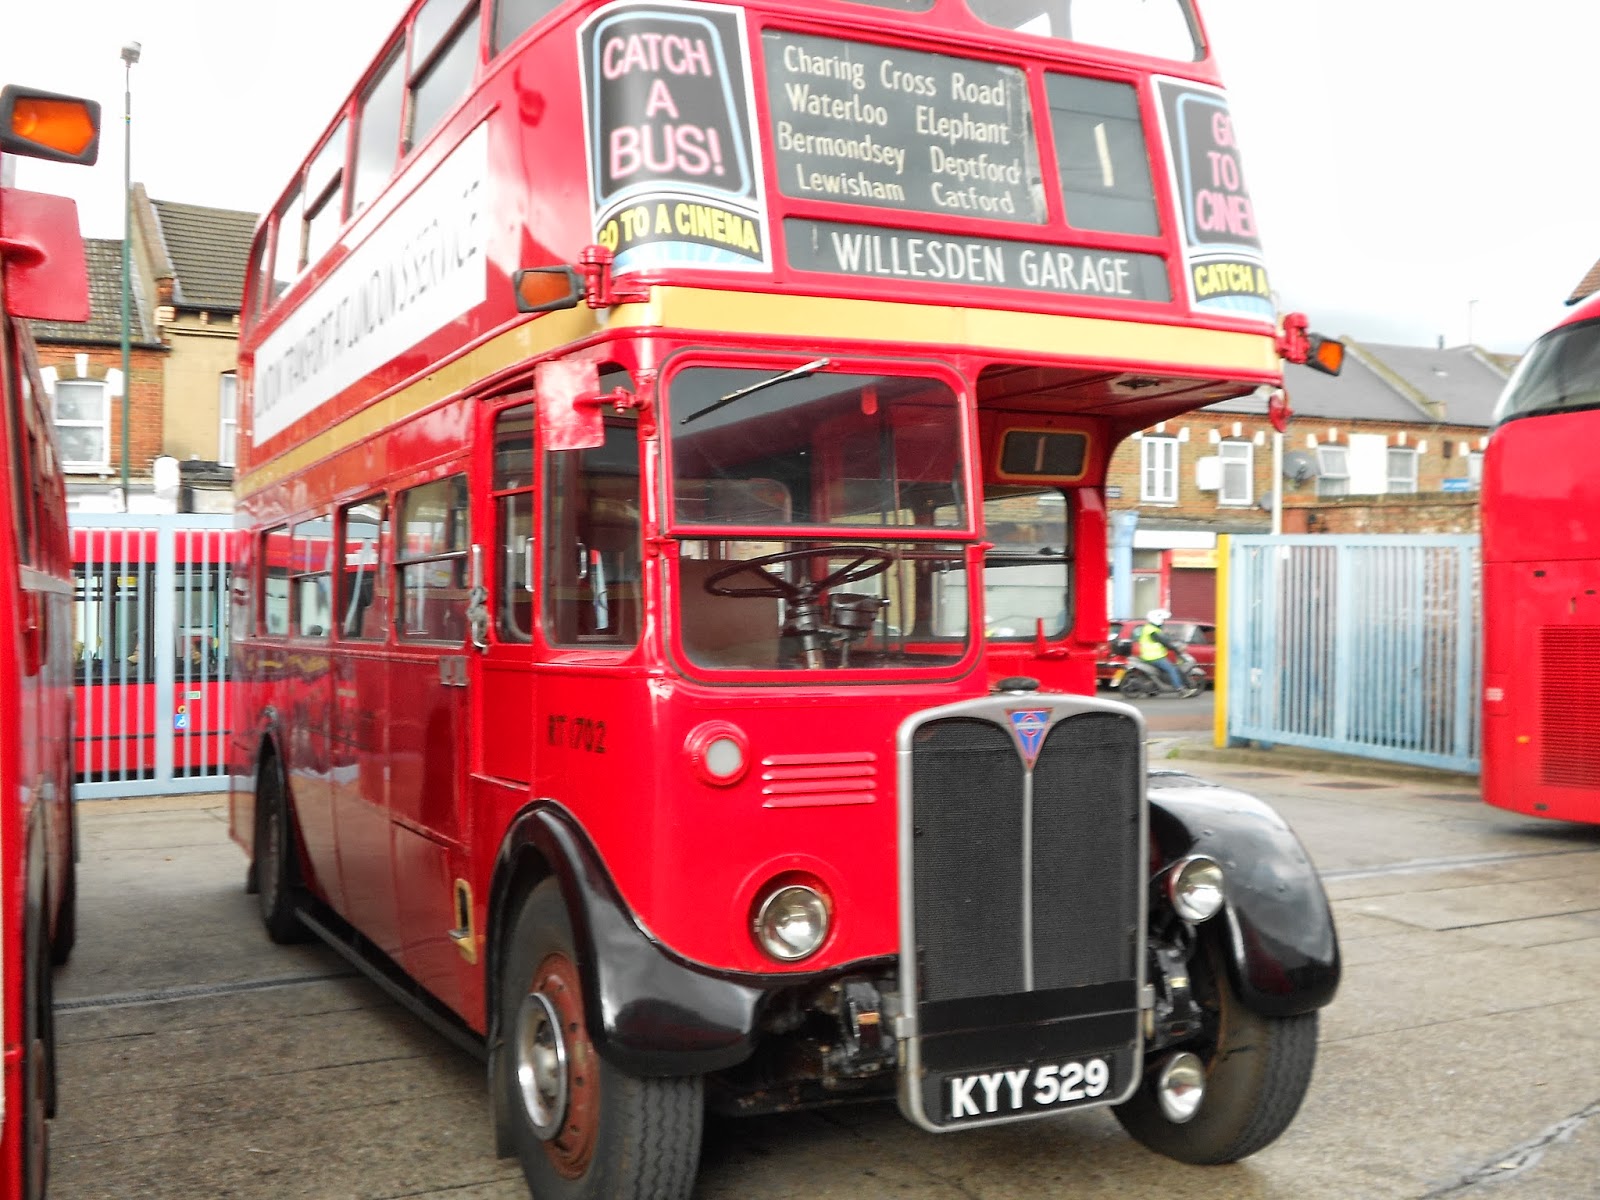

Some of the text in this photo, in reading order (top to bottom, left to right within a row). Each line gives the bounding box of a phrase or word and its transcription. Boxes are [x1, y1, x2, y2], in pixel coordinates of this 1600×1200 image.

[603, 33, 713, 79] CATCH
[783, 44, 1005, 107] Charing Cross Road
[645, 79, 679, 119] A
[785, 83, 1011, 145] Waterloo Elephant
[611, 124, 725, 179] BUS!
[777, 121, 1023, 185] Bermondsey Deptford
[1094, 123, 1114, 187] 1
[1207, 150, 1239, 192] TO
[796, 163, 1015, 214] Lewisham Catford
[620, 206, 650, 242] TO
[655, 203, 673, 234] A
[675, 203, 760, 253] CINEMA
[831, 231, 1132, 294] WILLESDEN GARAGE
[1194, 262, 1254, 296] CATCH
[952, 1058, 1110, 1119] KYY 529
